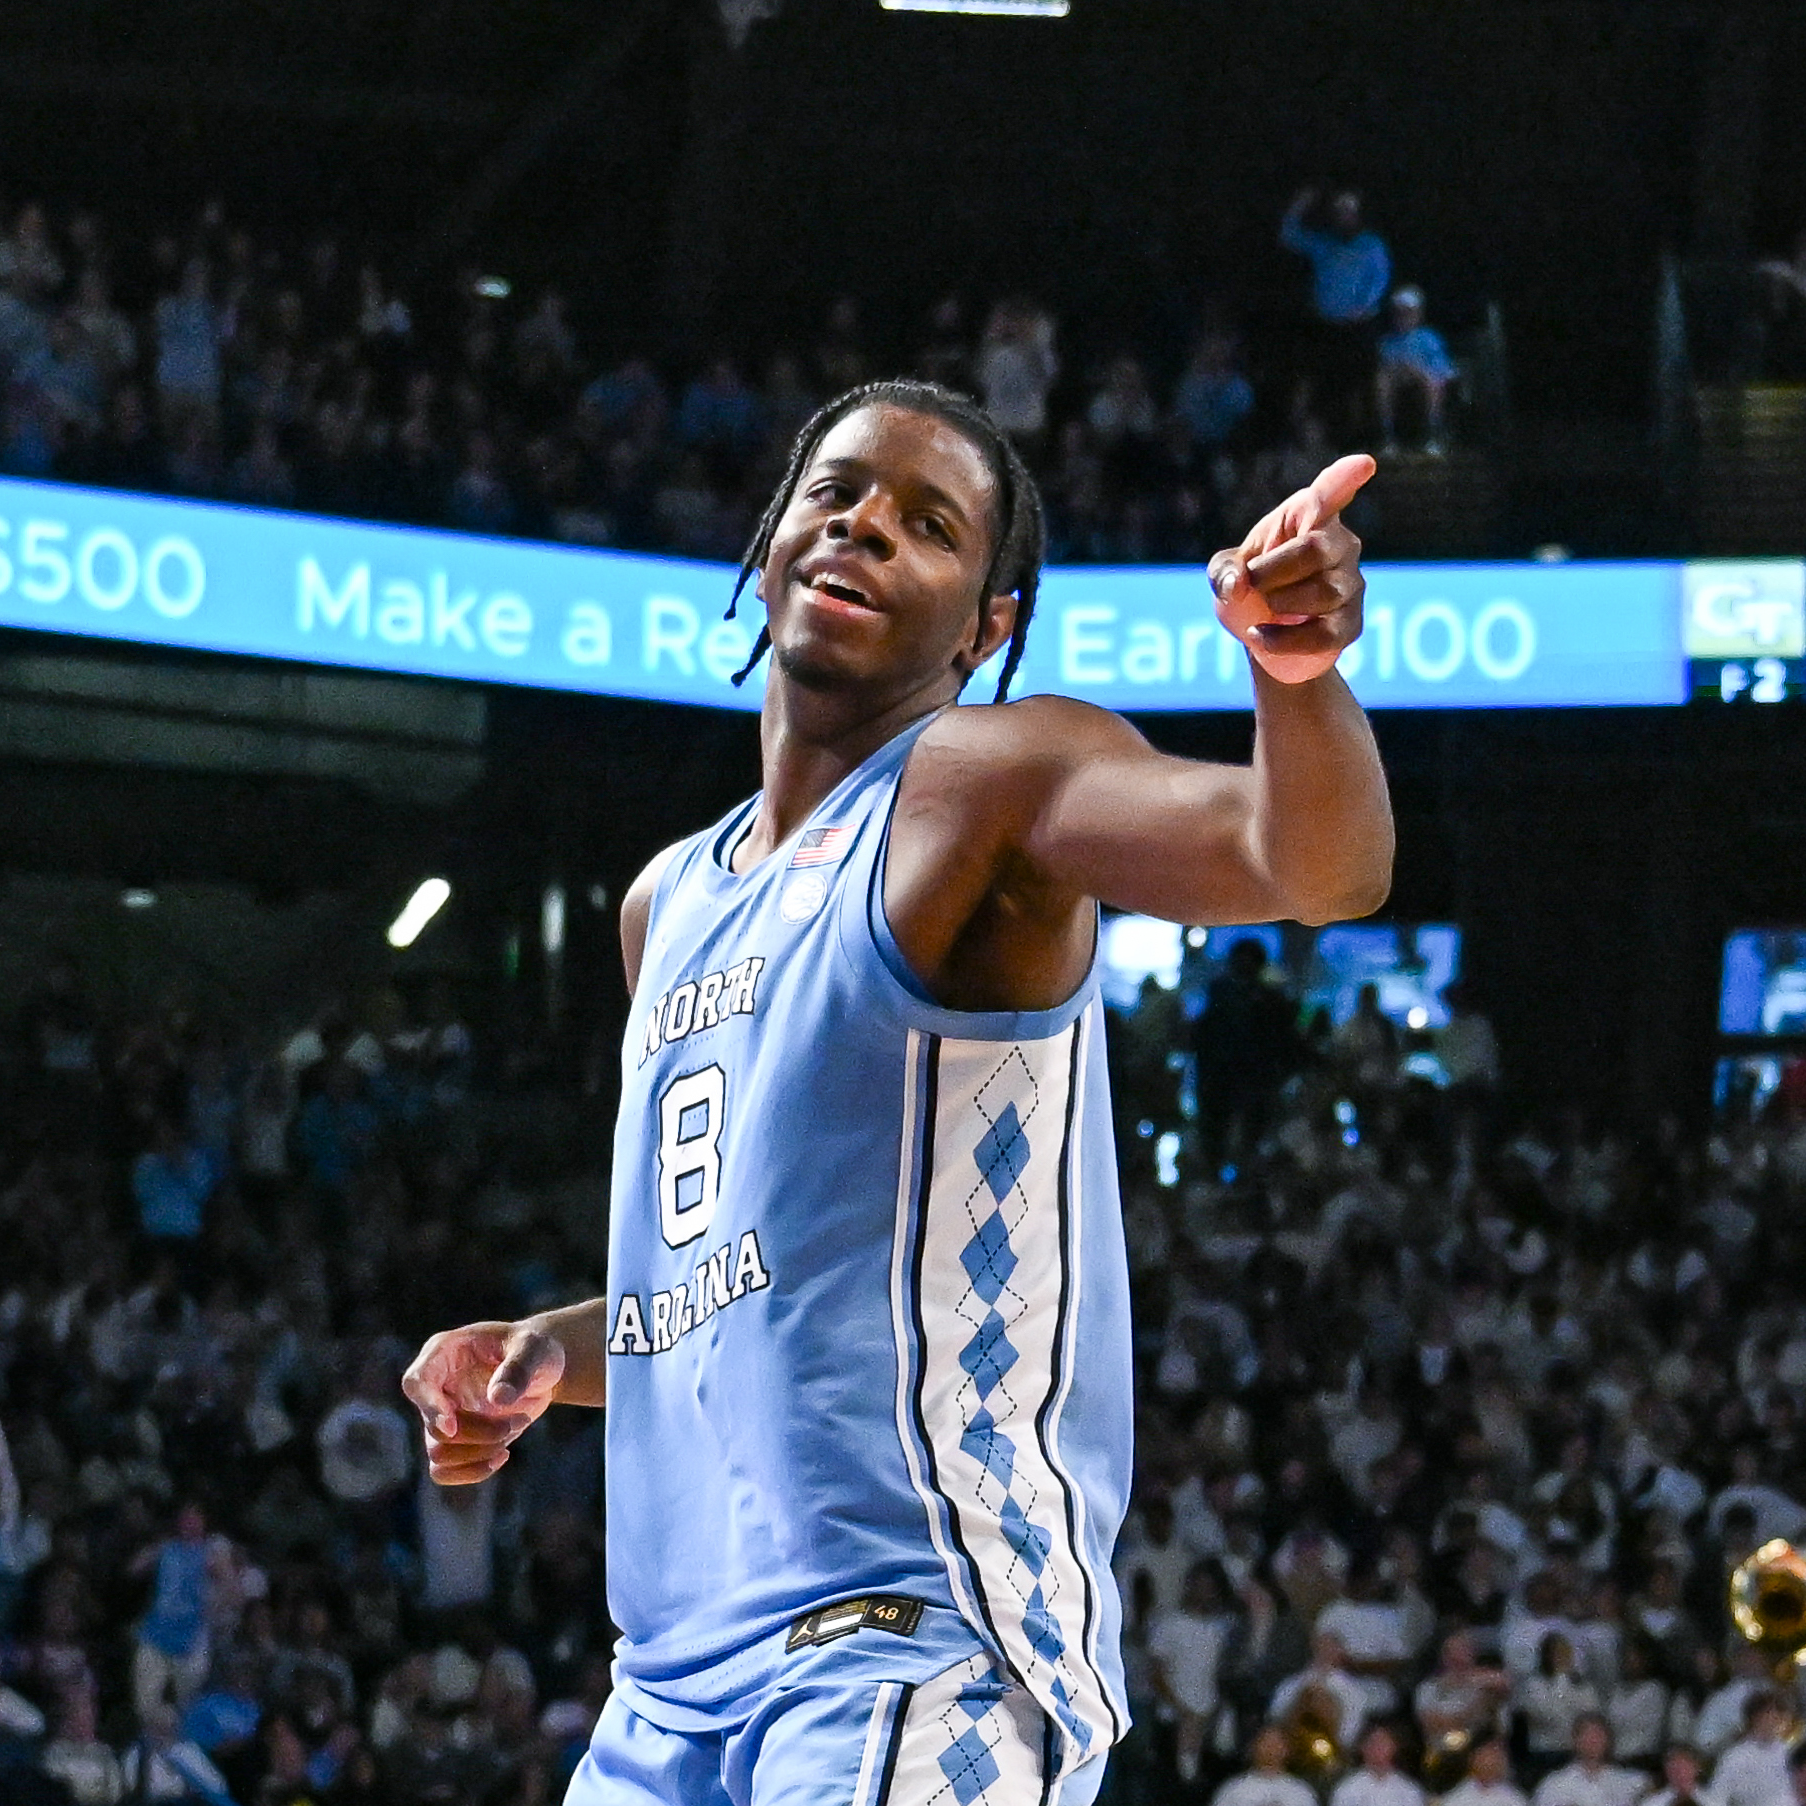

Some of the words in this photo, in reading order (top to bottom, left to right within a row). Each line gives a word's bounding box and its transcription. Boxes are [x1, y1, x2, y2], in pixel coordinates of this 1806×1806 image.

[295, 553, 535, 659] Make
[559, 601, 614, 668] a
[643, 592, 770, 686] Re
[1059, 602, 1241, 685] Ear
[1335, 598, 1537, 683] 100
[1750, 656, 1788, 702] 2
[638, 955, 767, 1072] NORTH
[656, 1061, 728, 1251] 8
[607, 1228, 770, 1356] AROLINA
[874, 1603, 900, 1621] 48
